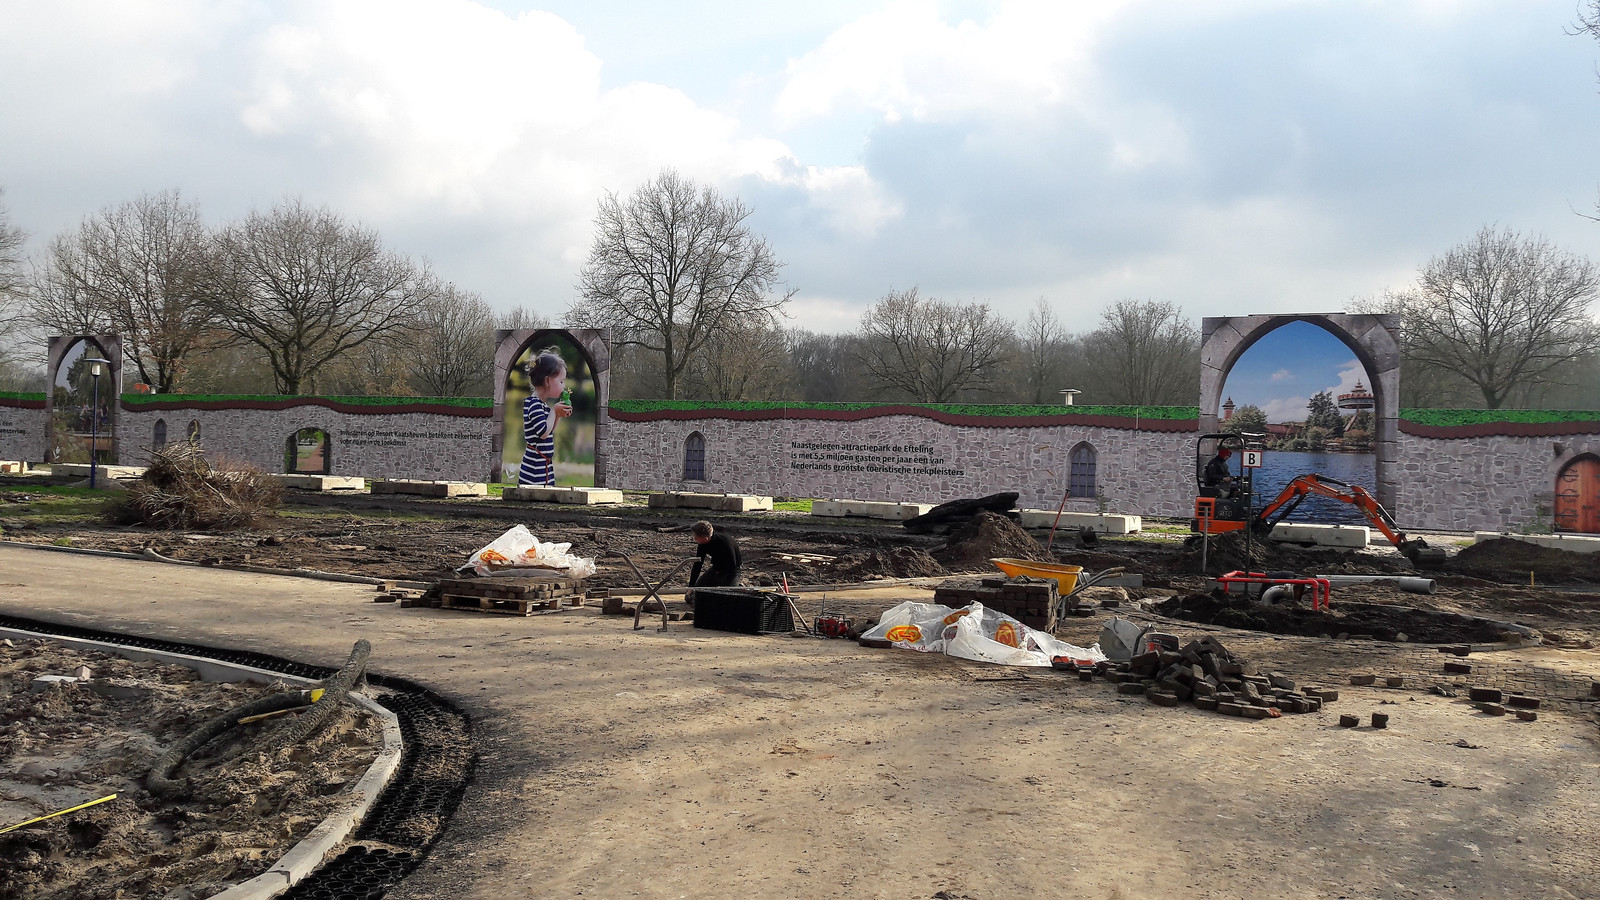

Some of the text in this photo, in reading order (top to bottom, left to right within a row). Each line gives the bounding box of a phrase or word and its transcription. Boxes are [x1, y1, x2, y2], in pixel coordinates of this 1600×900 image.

[791, 441, 934, 455] Naastgelegen attractiepark de Efteling
[791, 451, 797, 459] is
[798, 452, 813, 460] met
[814, 452, 825, 460] 5,5
[826, 452, 854, 462] miljoen
[855, 453, 881, 463] gasten
[882, 455, 895, 464] per
[896, 455, 912, 464] jaar
[913, 456, 928, 464] een
[1248, 453, 1256, 465] B
[791, 462, 964, 476] Nederlands grootste toeristische trekpleisters
